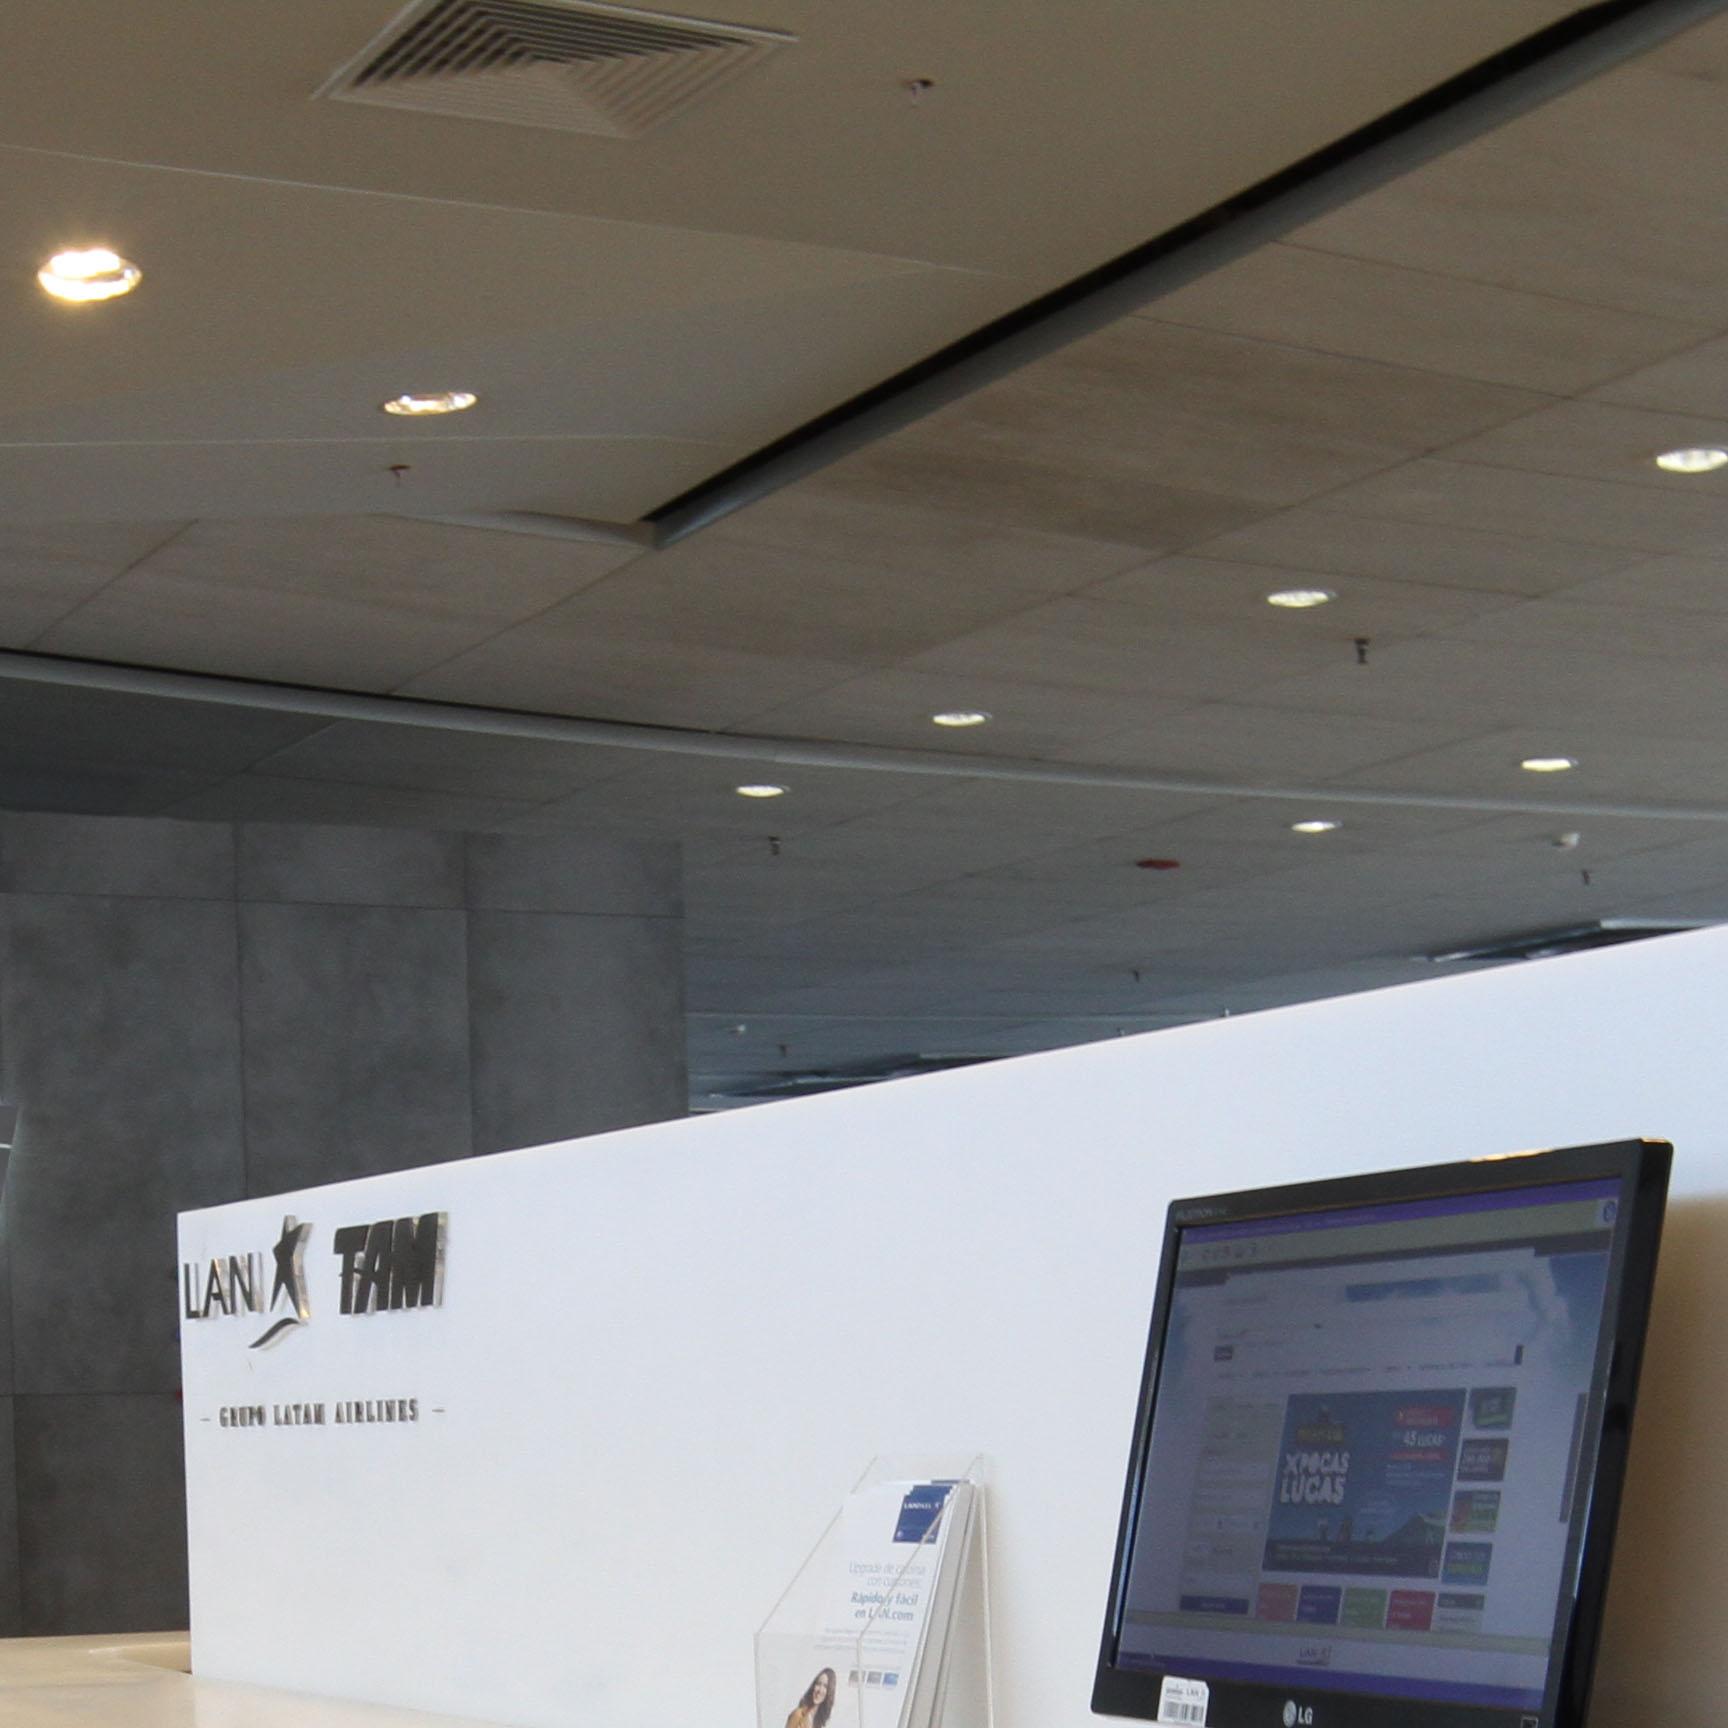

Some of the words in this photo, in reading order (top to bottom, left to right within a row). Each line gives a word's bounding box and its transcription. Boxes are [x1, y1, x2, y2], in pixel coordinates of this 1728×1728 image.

[334, 1211, 449, 1316] TAM
[183, 1251, 265, 1321] LAN
[219, 1404, 267, 1428] GRUPO
[335, 1398, 419, 1424] AIRLINES
[1280, 1474, 1347, 1505] LUCAS
[1297, 1706, 1313, 1726] LG
